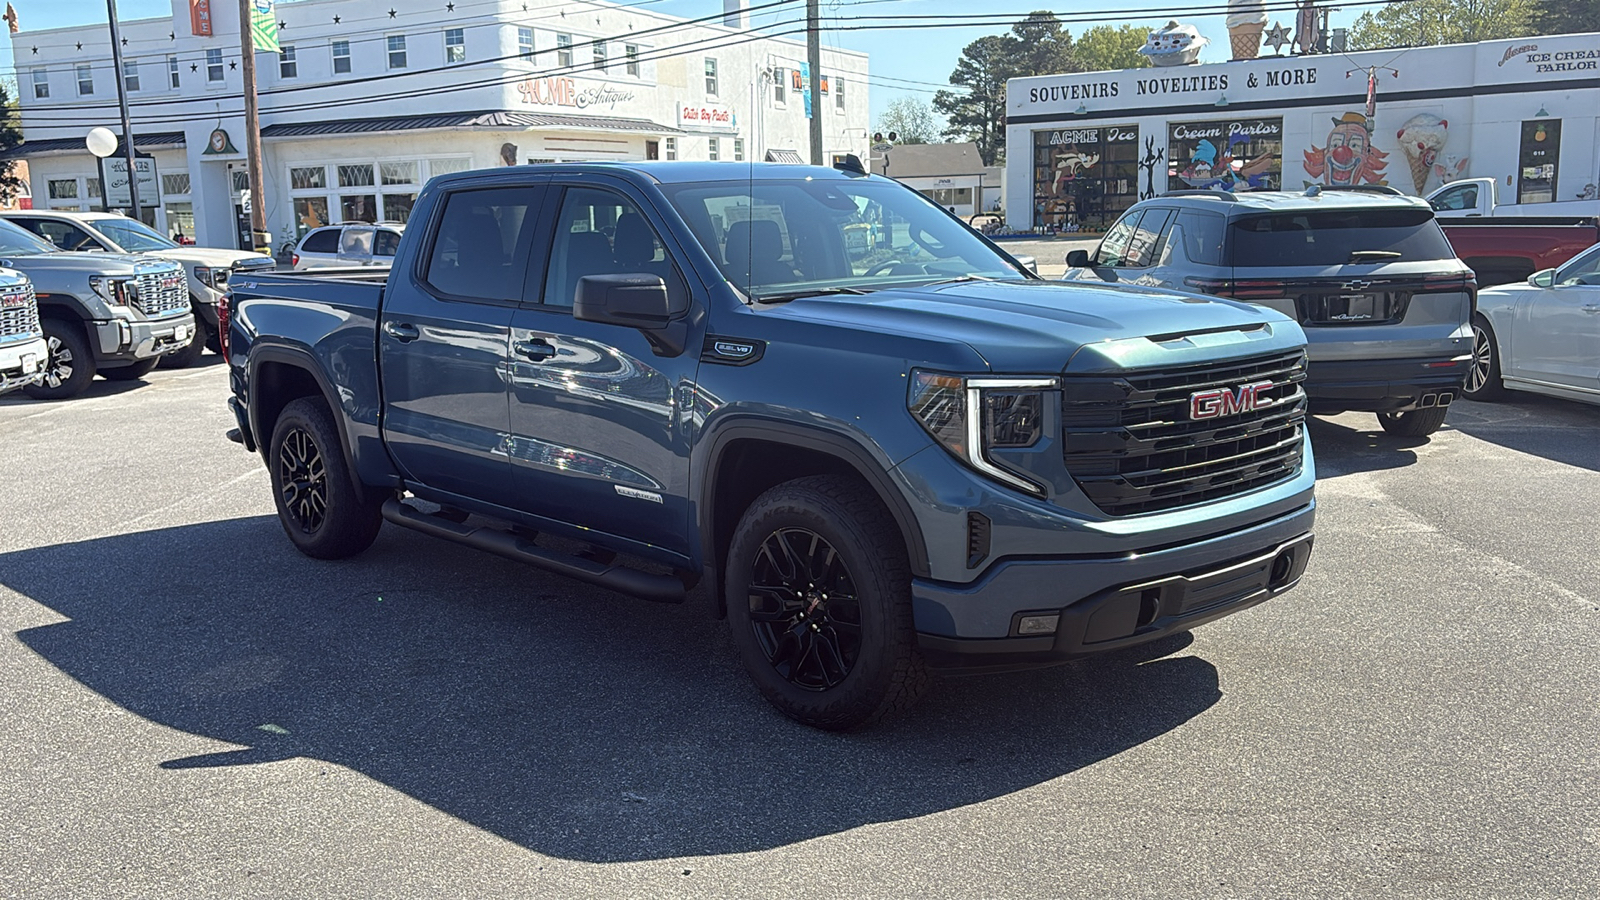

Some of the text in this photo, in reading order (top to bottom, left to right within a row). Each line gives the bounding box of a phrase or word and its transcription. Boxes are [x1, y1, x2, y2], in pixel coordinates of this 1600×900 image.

[1526, 53, 1551, 63] ICE
[1536, 61, 1597, 73] PARLOR
[517, 77, 576, 107] ACME
[1030, 68, 1317, 103] SOUVENIRS NOVELTIES & MORE
[683, 107, 699, 119] Dutch
[701, 108, 711, 123] Boy
[1050, 128, 1136, 145] ACME Ice
[1173, 122, 1279, 139] Cream Parlor
[1190, 380, 1273, 420] GMC
